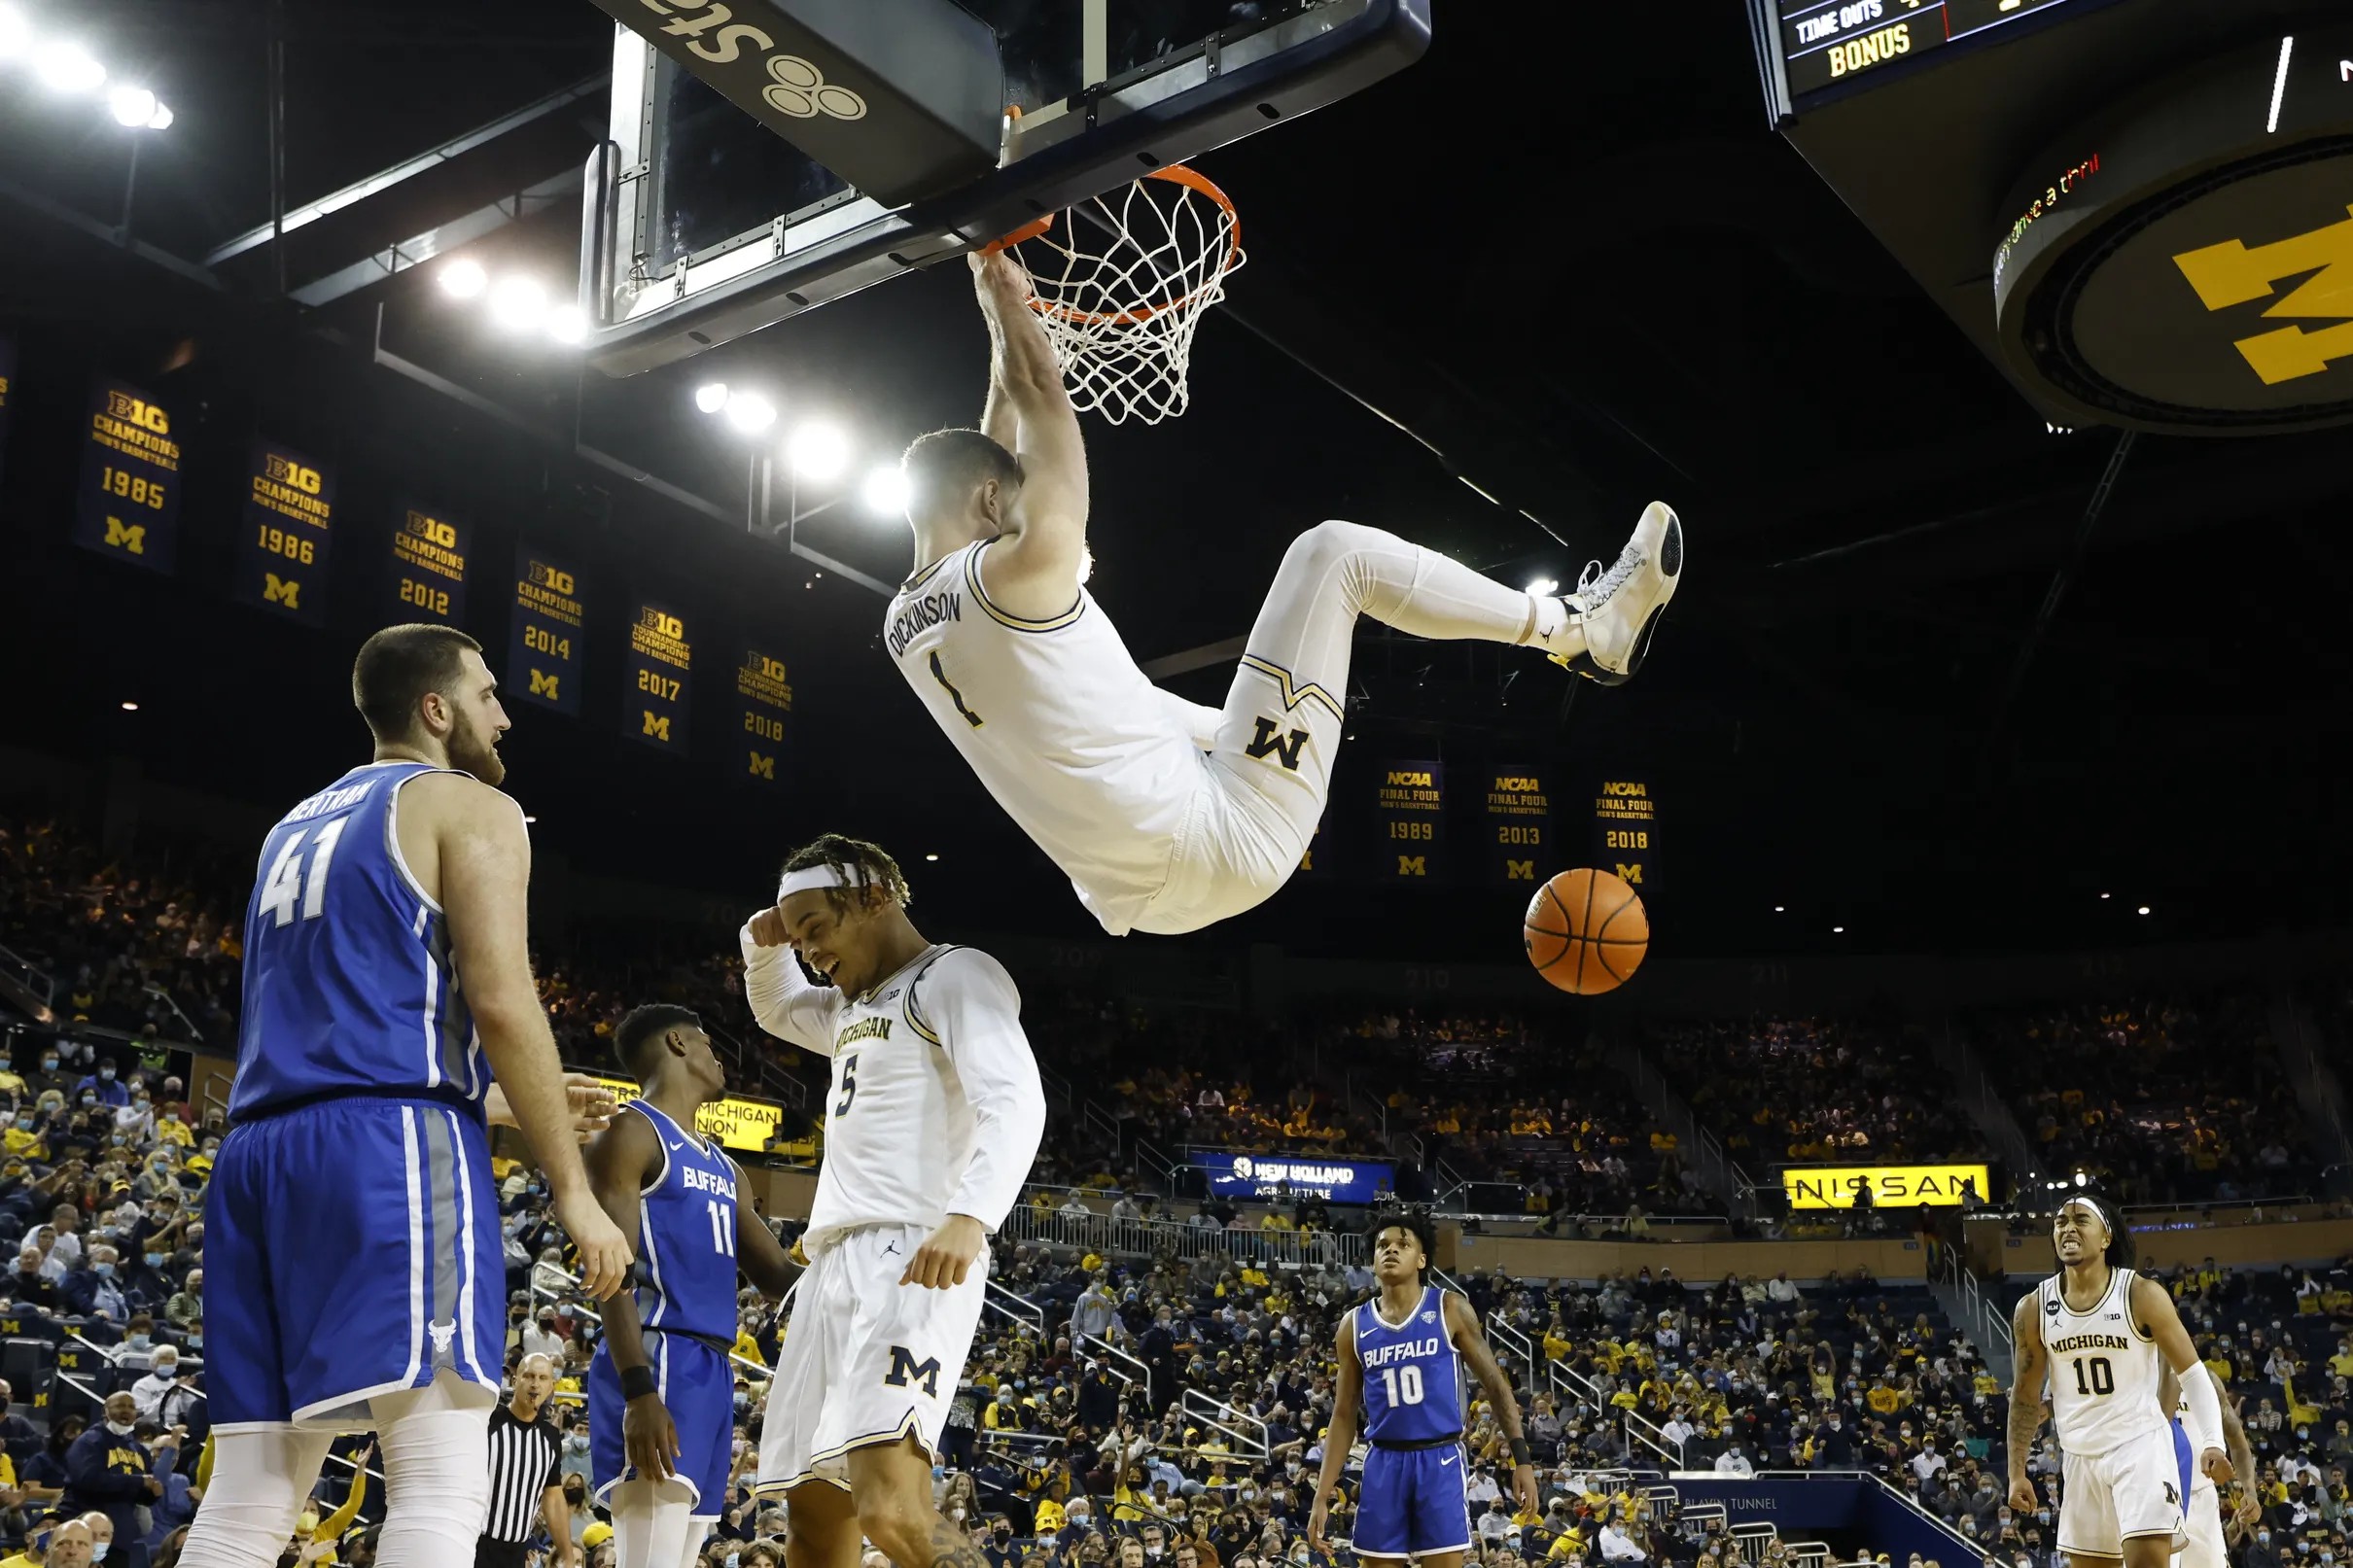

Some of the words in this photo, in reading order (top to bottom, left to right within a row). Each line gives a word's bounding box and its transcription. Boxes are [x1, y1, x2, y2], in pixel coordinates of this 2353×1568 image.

[1796, 12, 1839, 44] TIME
[1840, 0, 1883, 28] OUTS
[1828, 23, 1911, 78] BONUS
[93, 414, 179, 459] CHAMPIONS
[101, 467, 164, 509] 1985
[253, 475, 330, 517] CHAMPIONS
[104, 515, 145, 554] M
[259, 525, 314, 564] 1986
[395, 532, 464, 571] CHAMPIONS
[263, 573, 299, 610] M
[401, 578, 449, 615] 2012
[518, 580, 582, 616] CHAMPIONS
[633, 623, 690, 651] TOURNAMENT
[889, 592, 961, 658] DICKINSON
[525, 625, 570, 660] 2014
[632, 631, 689, 661] CHAMPIONS
[651, 648, 689, 670] BASKETBALL
[529, 668, 559, 700] M
[638, 669, 681, 701] 2017
[930, 650, 983, 728] 1
[643, 710, 670, 742] M
[745, 712, 783, 741] 2018
[750, 750, 774, 780] M
[1387, 772, 1431, 786] NCAA
[1380, 788, 1410, 800] FINAL
[1413, 790, 1440, 802] FOUR
[1488, 794, 1518, 805] FINAL
[1521, 795, 1548, 806] FOUR
[1495, 778, 1539, 791] NCAA
[1603, 782, 1646, 796] NCAA
[282, 779, 377, 824] BERTRAM
[1596, 799, 1626, 810] FINAL
[1628, 800, 1653, 811] FOUR
[1390, 822, 1432, 840] 1989
[1499, 826, 1539, 844] 2013
[1607, 831, 1648, 849] 2018
[258, 815, 351, 928] 41
[1398, 855, 1425, 876] M
[1507, 859, 1533, 880] M
[1616, 863, 1642, 884] M
[834, 1016, 894, 1060] MICHIGAN
[835, 1054, 859, 1119] 5
[696, 1118, 737, 1135] NION
[698, 1102, 778, 1125] MICHIGAN
[1255, 1163, 1287, 1181] NEW
[1289, 1166, 1353, 1184] HOLLAND
[1796, 1174, 1976, 1200] NISSAN
[707, 1199, 734, 1258] 11
[1363, 1338, 1438, 1369] BUFFALO
[2051, 1335, 2129, 1353] MICHIGAN
[58, 1354, 78, 1368] M
[885, 1345, 941, 1400] M
[2073, 1357, 2115, 1395] 10
[1382, 1365, 1424, 1408] 10
[1731, 1498, 1776, 1510] TUNNEL
